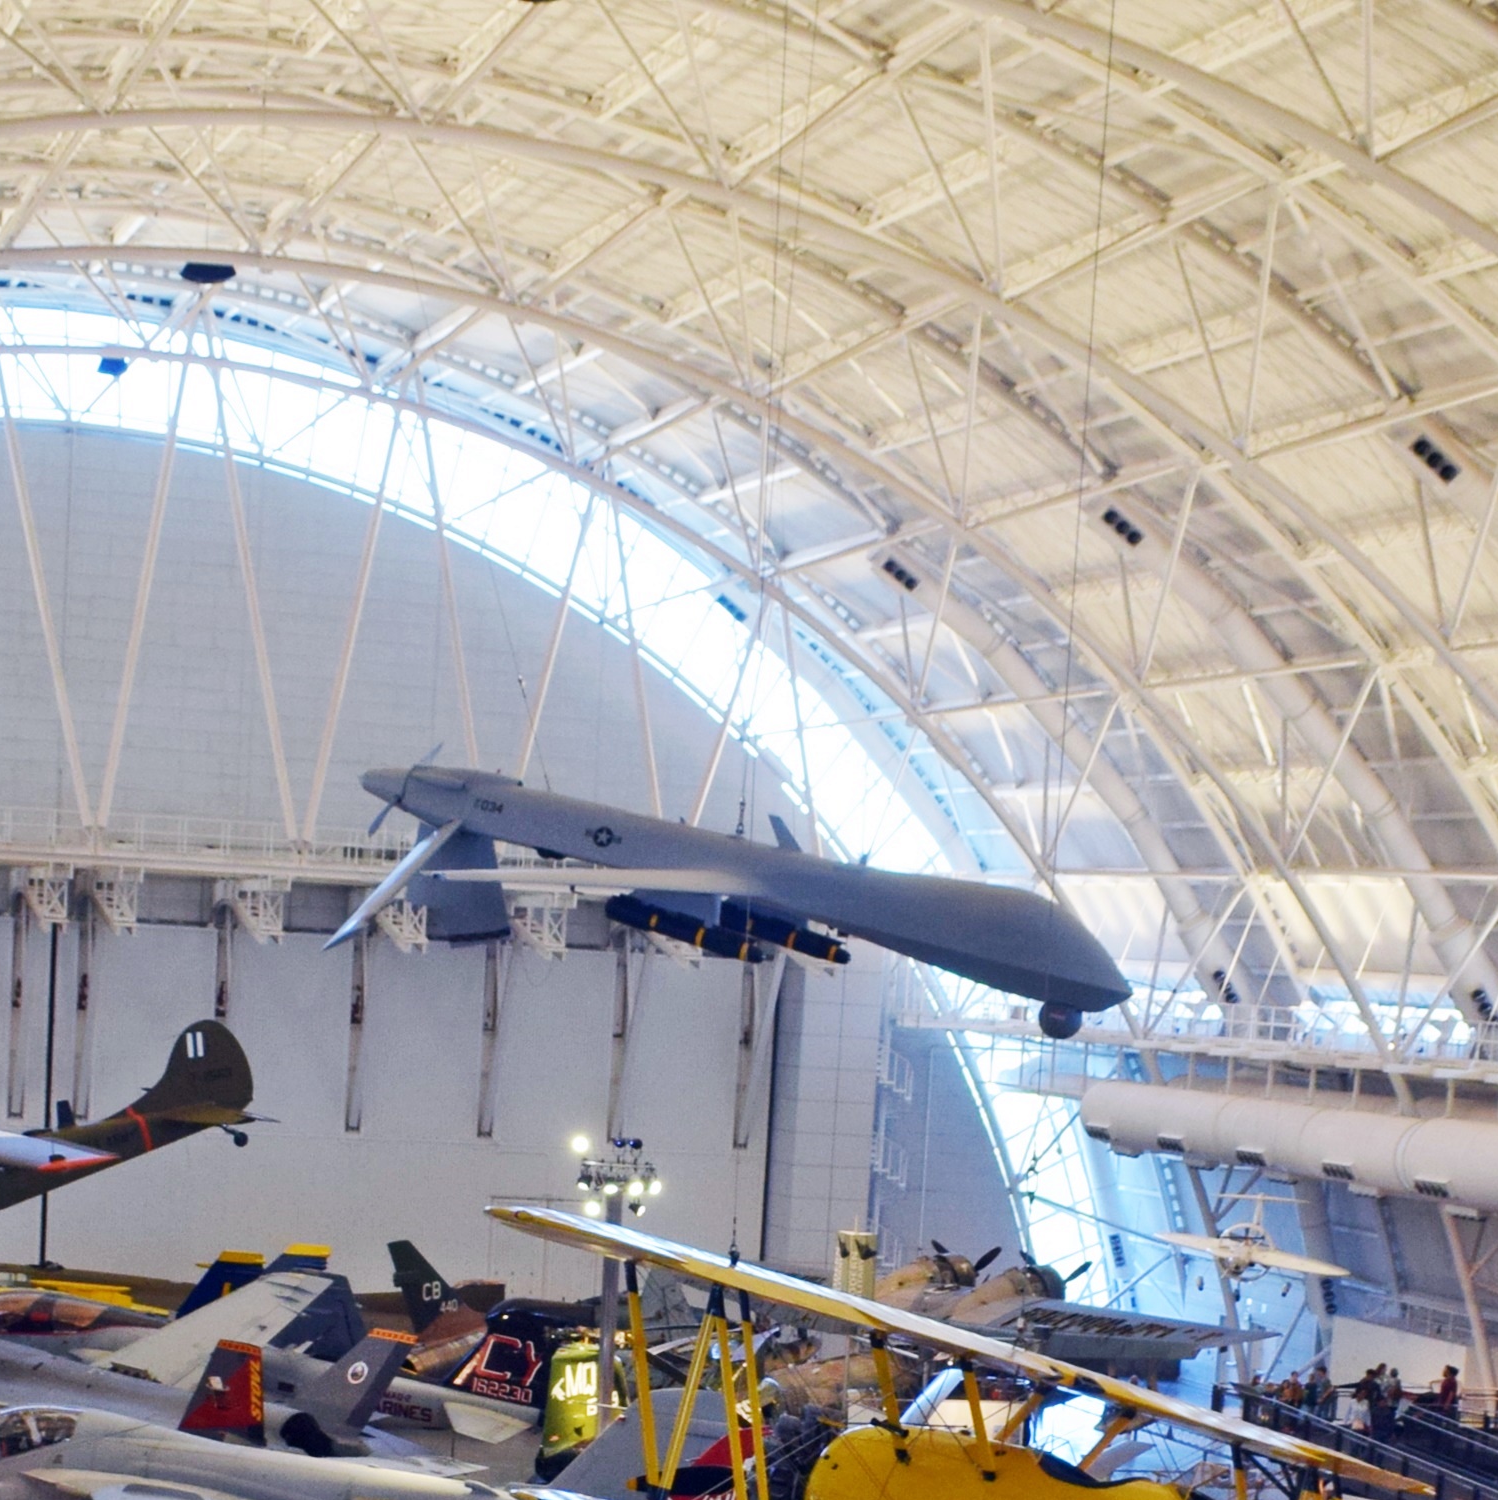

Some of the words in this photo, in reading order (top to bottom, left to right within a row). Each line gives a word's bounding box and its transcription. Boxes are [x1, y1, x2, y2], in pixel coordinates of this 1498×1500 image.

[422, 1281, 442, 1302] CB
[440, 1299, 459, 1312] 440
[475, 1334, 543, 1386] CY
[250, 1359, 262, 1422] STOVL
[471, 1377, 533, 1404] 162230
